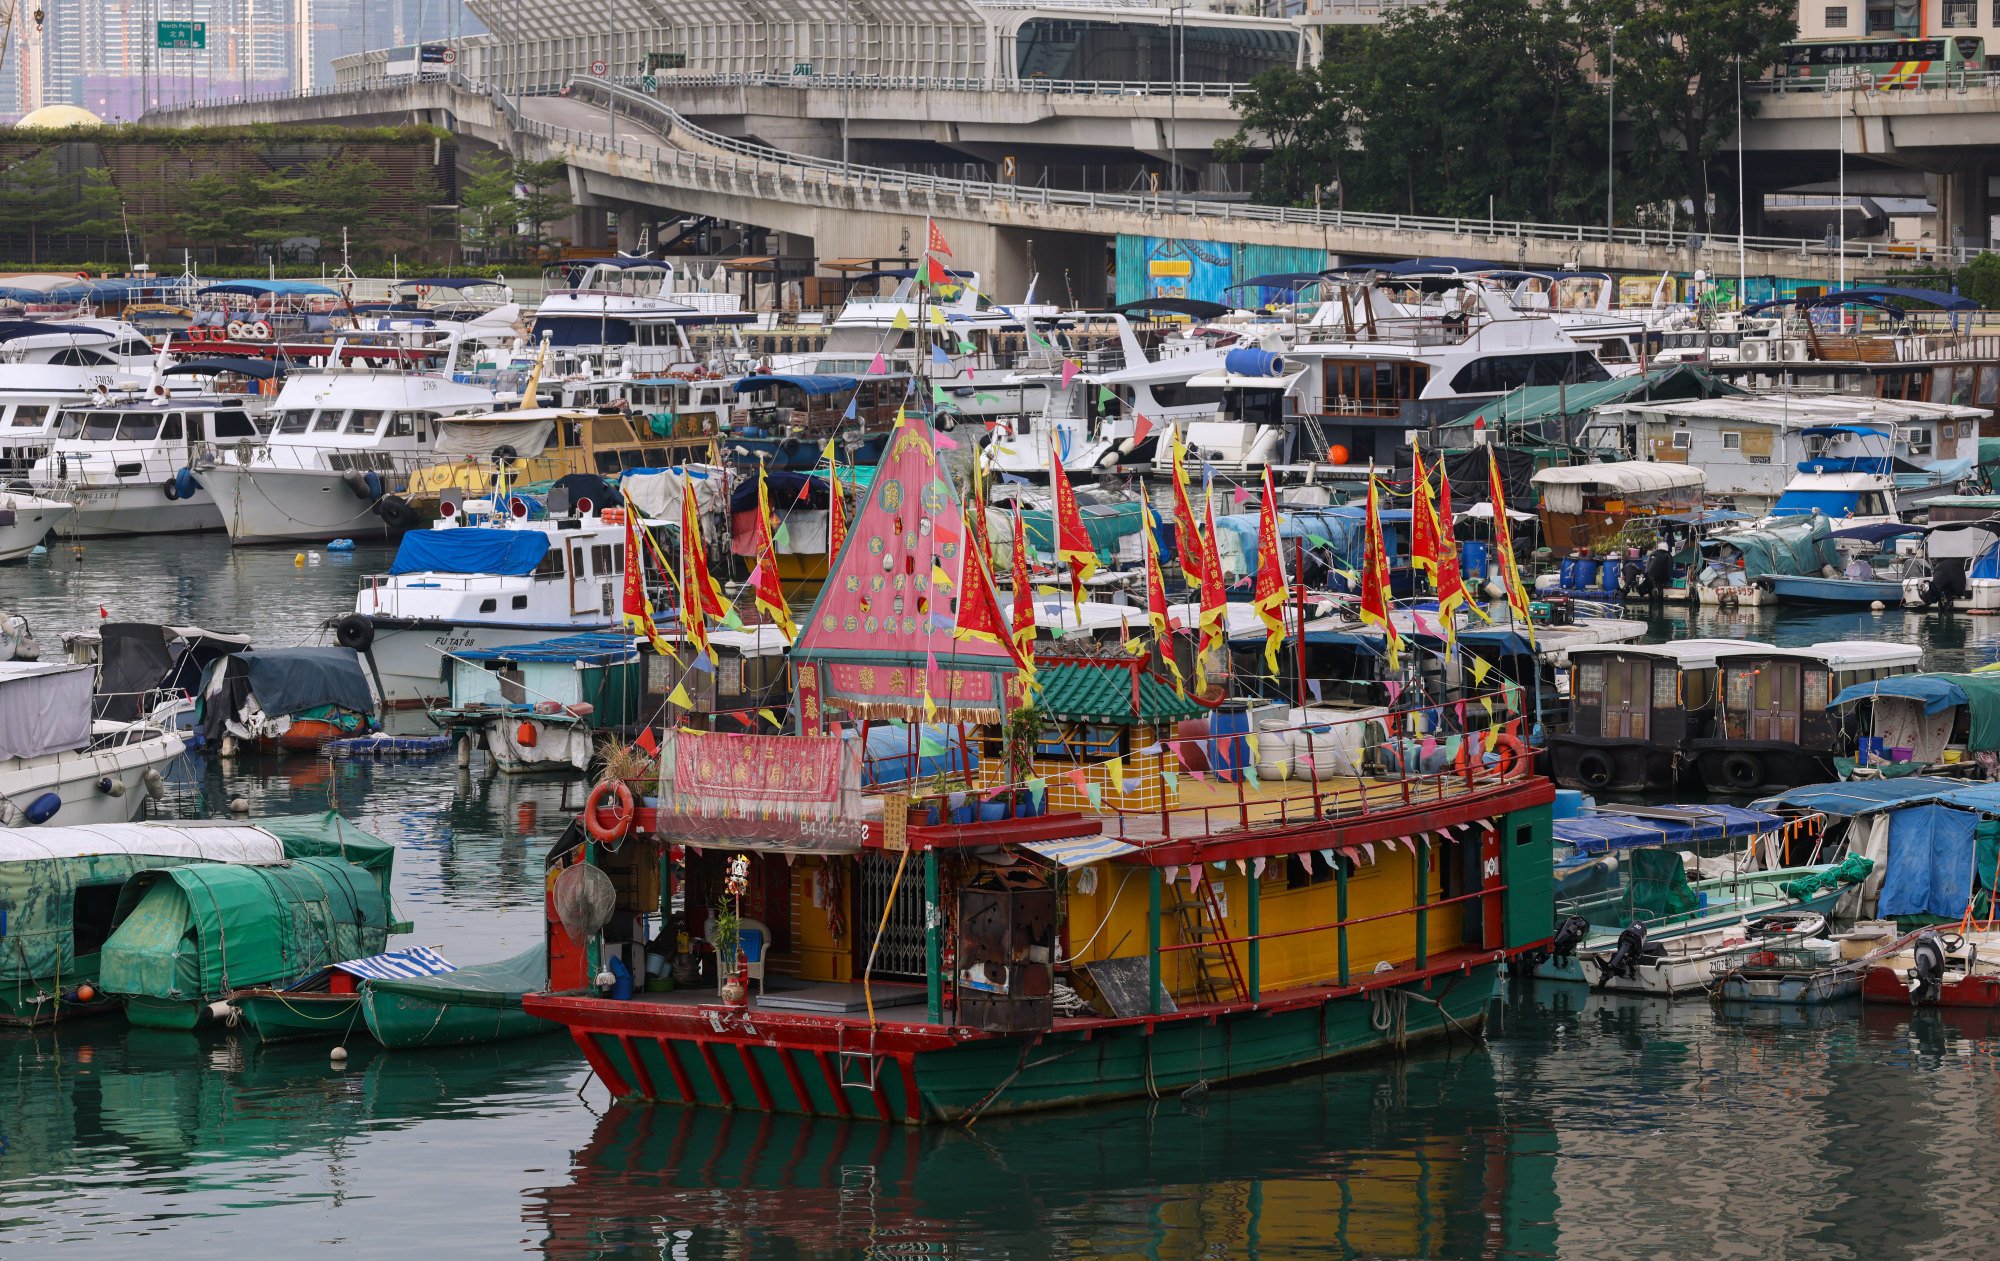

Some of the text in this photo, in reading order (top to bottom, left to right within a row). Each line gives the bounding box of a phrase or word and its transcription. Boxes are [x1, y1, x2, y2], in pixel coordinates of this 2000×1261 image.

[435, 637, 475, 647] FU TAT 88
